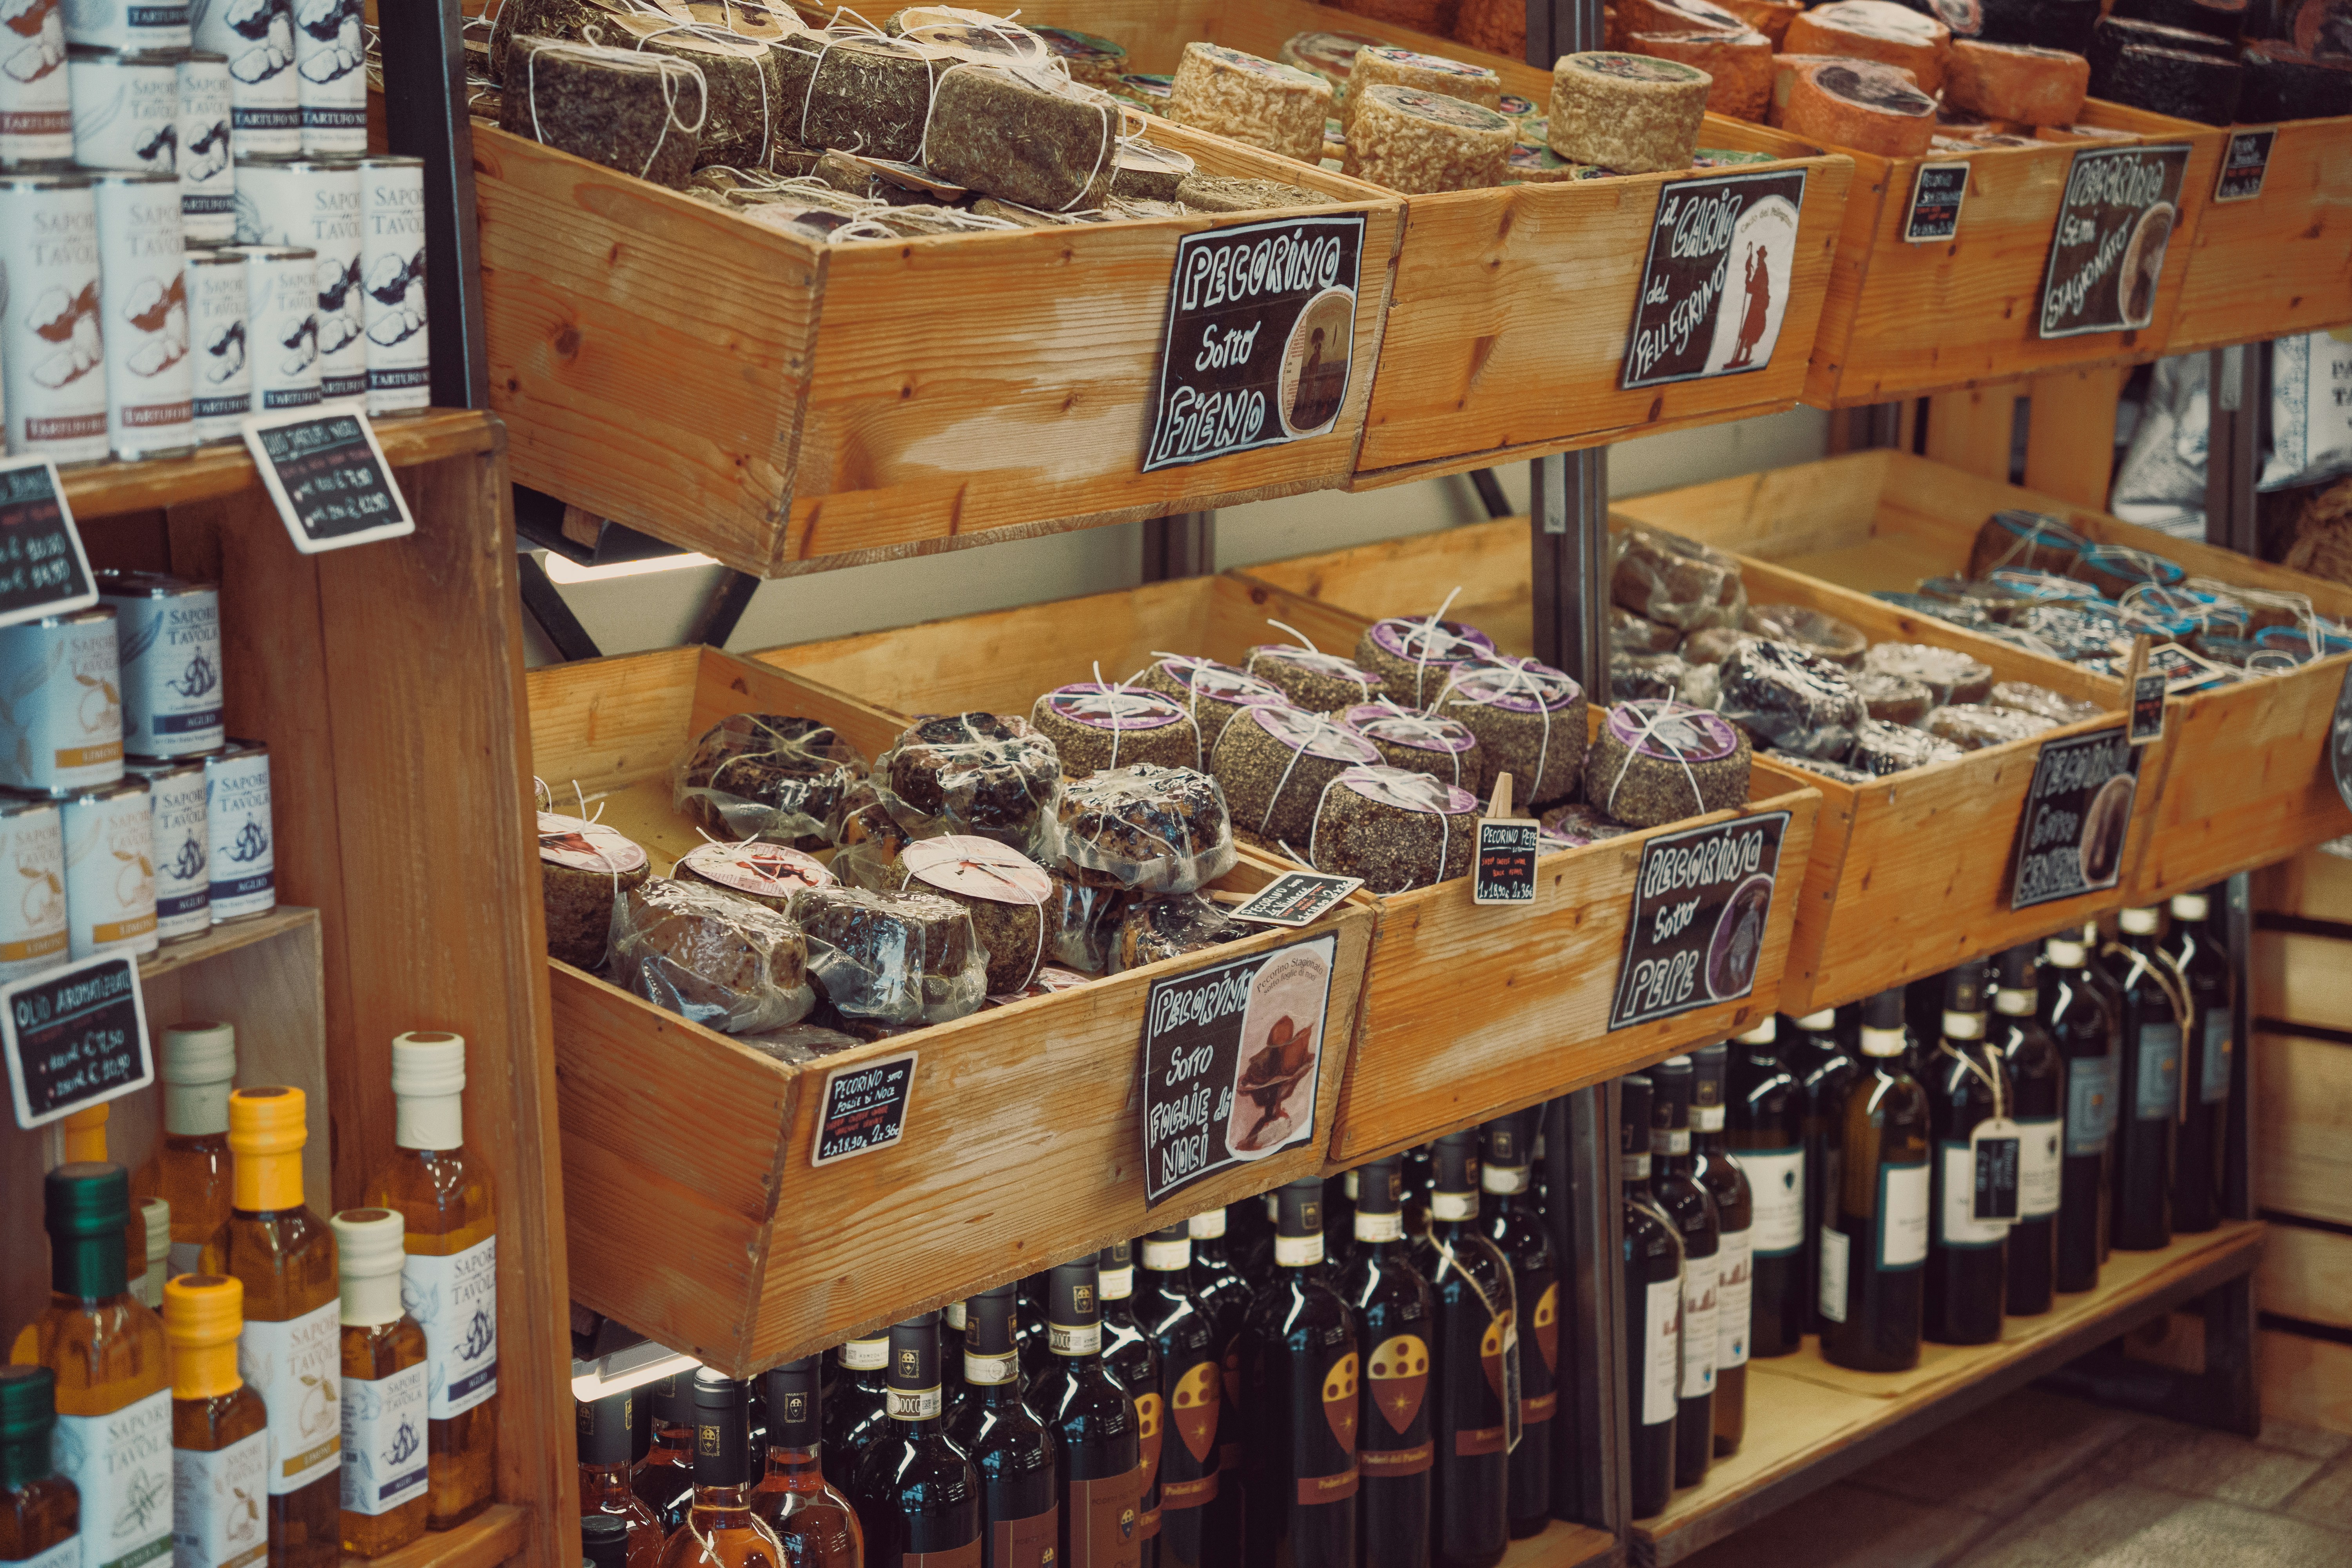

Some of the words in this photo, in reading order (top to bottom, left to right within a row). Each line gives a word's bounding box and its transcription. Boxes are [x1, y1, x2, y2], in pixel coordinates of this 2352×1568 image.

[1660, 195, 1680, 226] il
[1182, 228, 1341, 311] PECORINO
[1646, 274, 1670, 305] del
[1195, 320, 1261, 372] Sotto
[1156, 385, 1265, 461] FIENO
[1484, 826, 1519, 844] PECORINO
[1521, 828, 1537, 848] PEPE
[1644, 826, 1764, 899] PECORINO
[1240, 887, 1288, 916] PECORINO
[1256, 962, 1289, 993] Pecorino
[1291, 957, 1323, 975] Stagionato
[1263, 978, 1279, 996] sotto
[1281, 969, 1297, 982] foglie
[1622, 950, 1699, 1018] PEPE
[1153, 968, 1254, 1038] PECORINO
[834, 1069, 883, 1100] PECORINO
[874, 1086, 895, 1101] NOCE
[1150, 1082, 1211, 1149] FOGLIE
[1162, 1123, 1209, 1186] NOCI
[901, 1397, 920, 1413] DOCG
